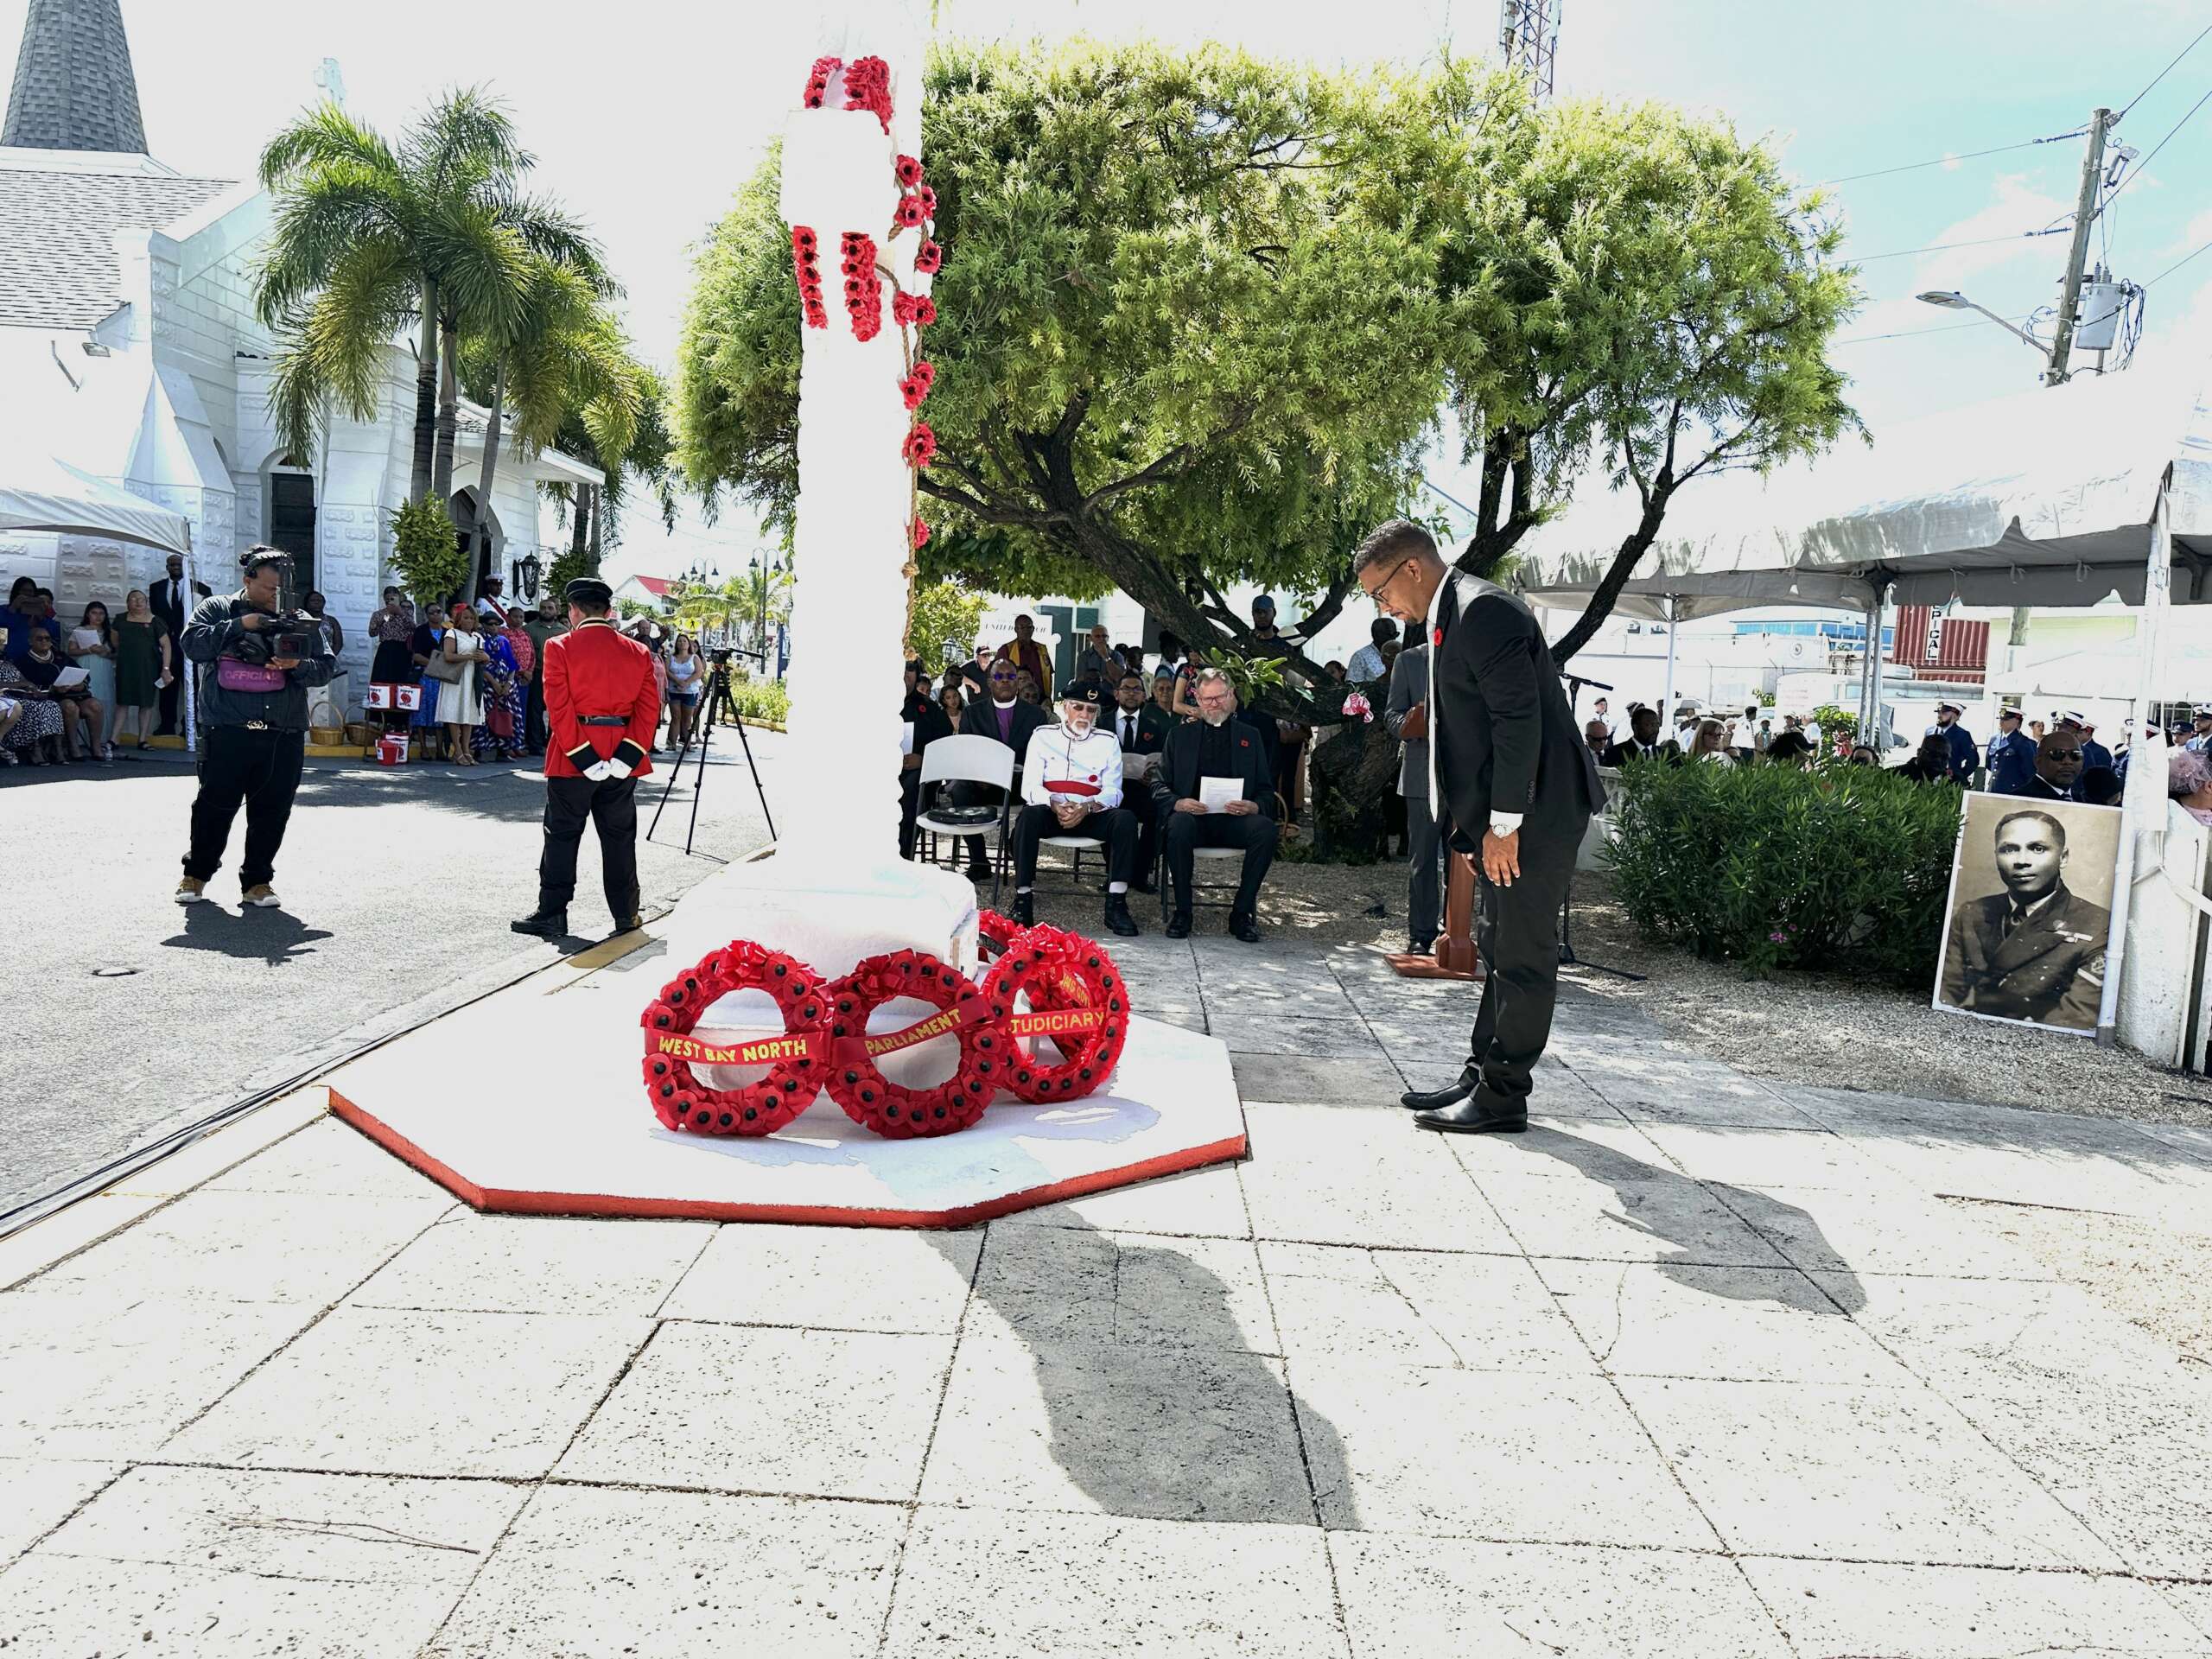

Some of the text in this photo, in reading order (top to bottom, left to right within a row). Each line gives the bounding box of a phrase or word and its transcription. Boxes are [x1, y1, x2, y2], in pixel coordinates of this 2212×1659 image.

[225, 671, 277, 681] OFFICIAL
[864, 1008, 961, 1055] PARLIAMENT
[1009, 1011, 1104, 1034] JUDICIARY
[658, 1036, 808, 1063] WEST BAY NORTH
